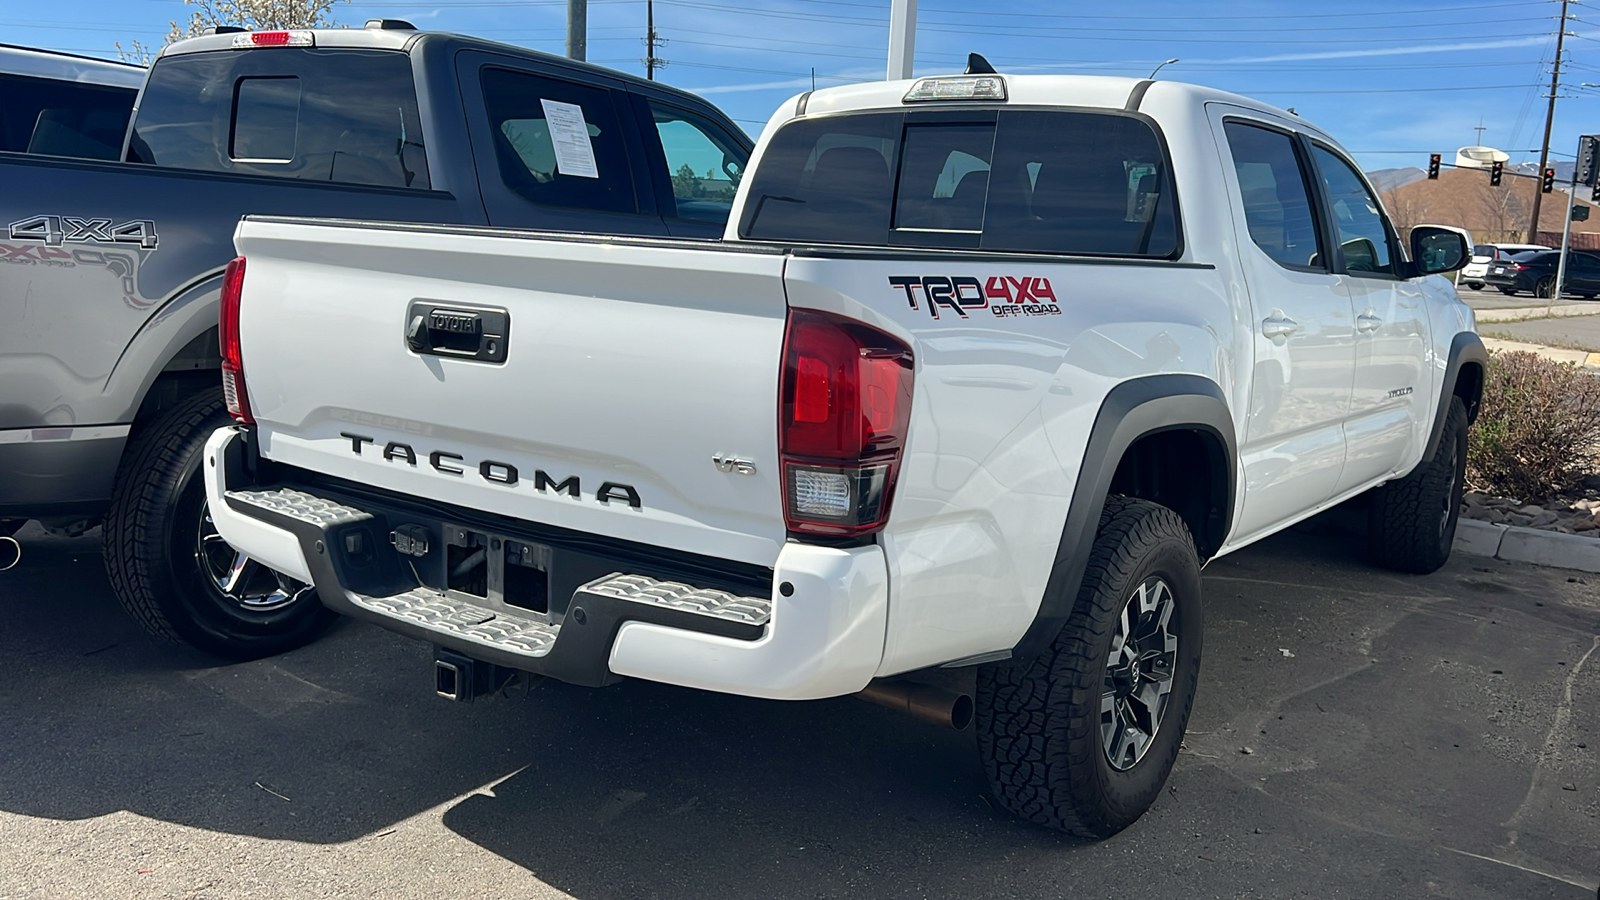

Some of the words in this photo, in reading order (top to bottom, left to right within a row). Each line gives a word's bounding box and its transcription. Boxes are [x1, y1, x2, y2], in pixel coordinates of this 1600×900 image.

[888, 276, 987, 318] TRD
[985, 276, 1057, 304] 4X4
[992, 305, 1020, 316] OFF
[1022, 304, 1061, 316] ROAD
[431, 315, 474, 333] TOYOTA
[340, 431, 642, 508] TACOMA
[712, 456, 757, 476] V6
